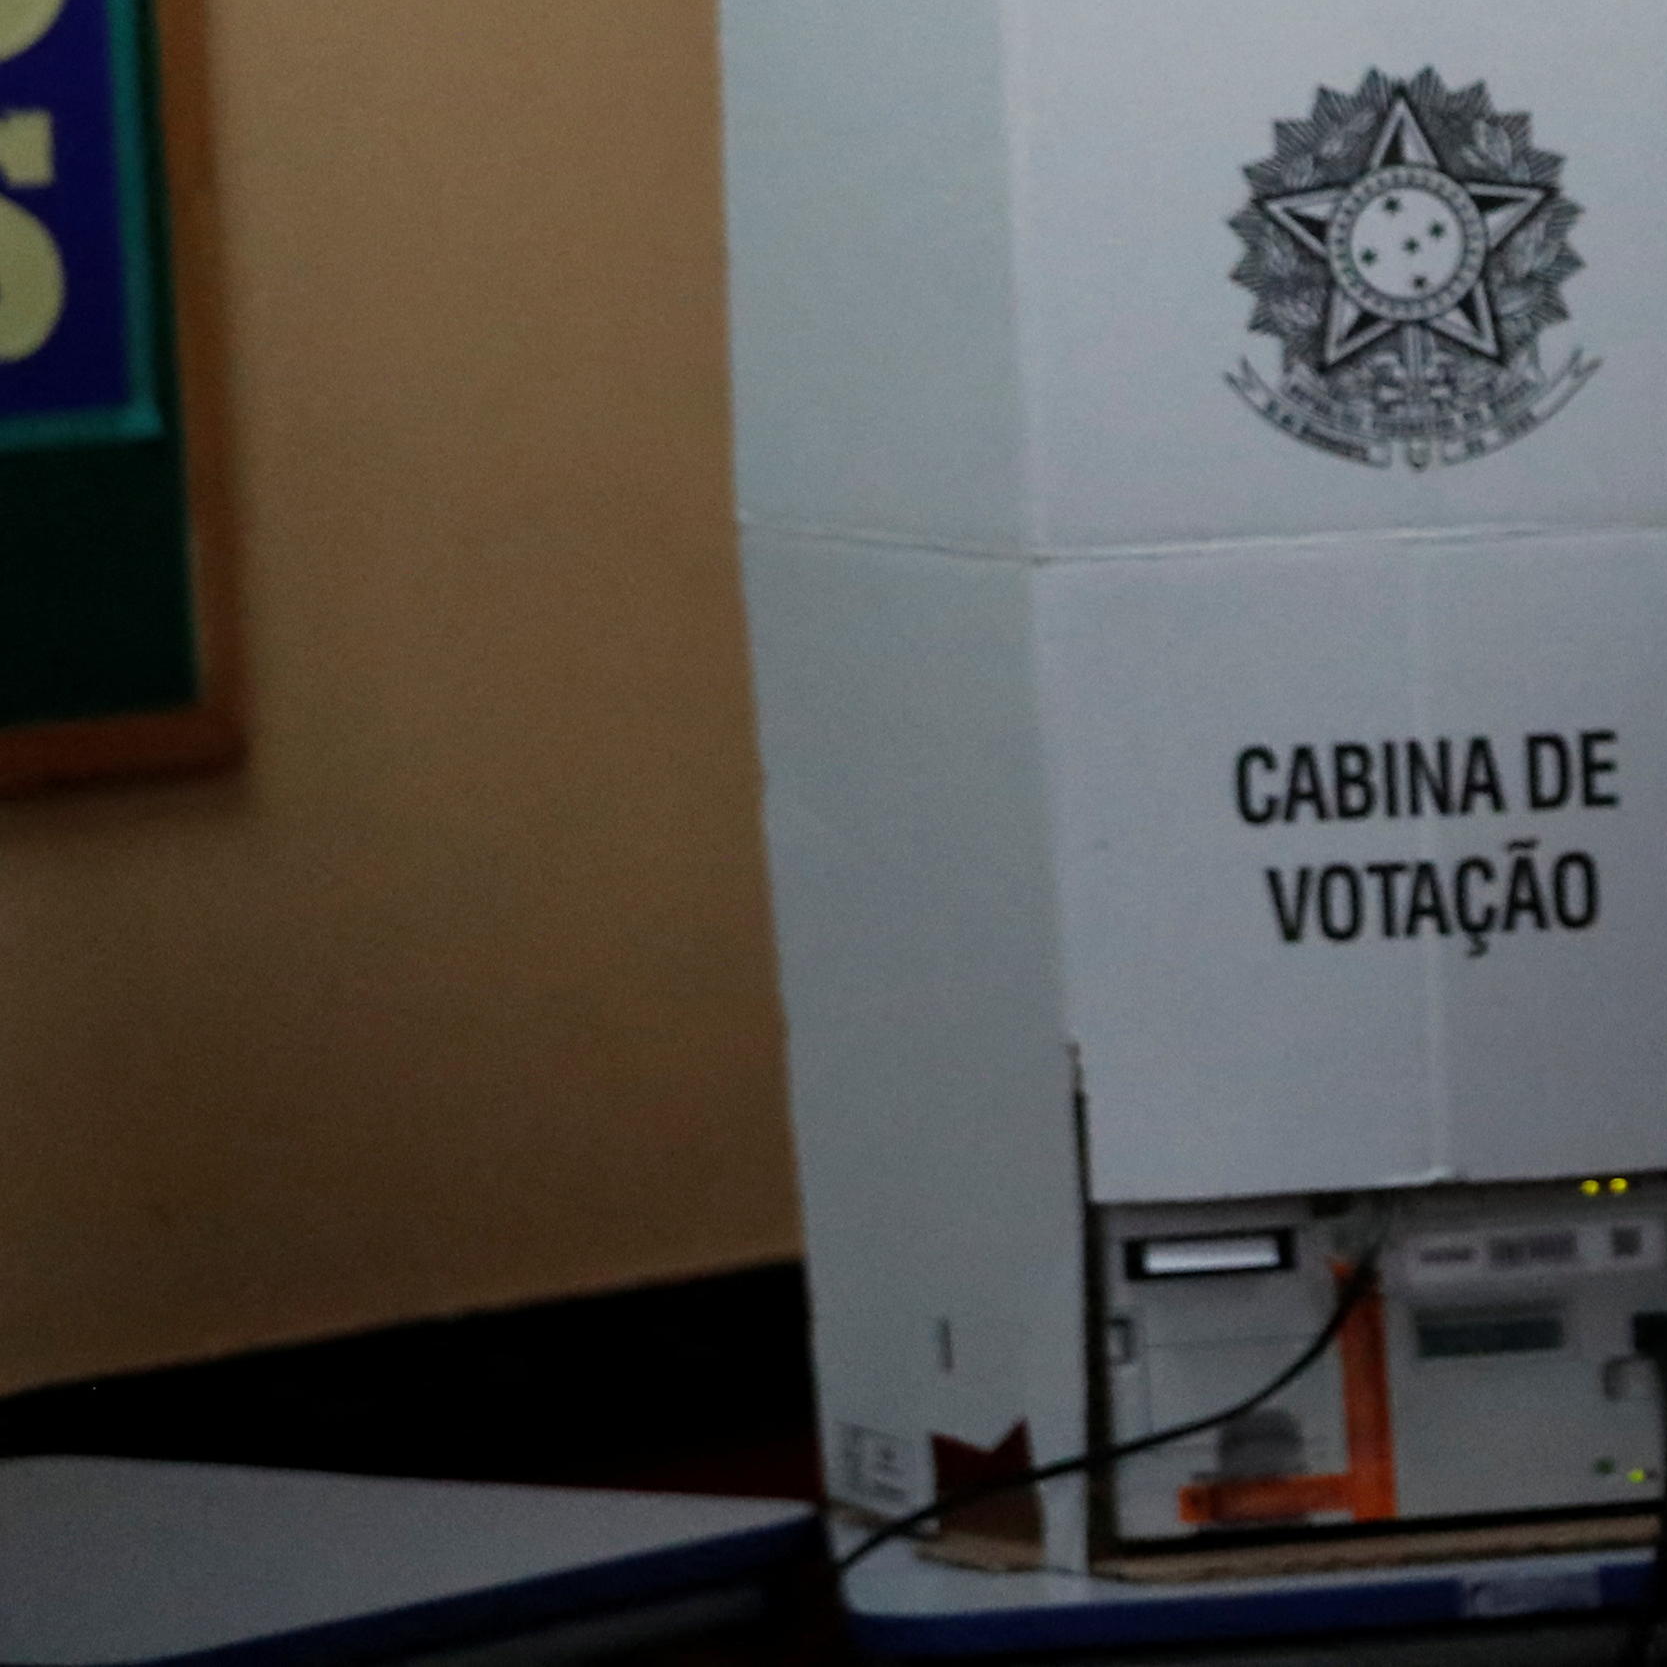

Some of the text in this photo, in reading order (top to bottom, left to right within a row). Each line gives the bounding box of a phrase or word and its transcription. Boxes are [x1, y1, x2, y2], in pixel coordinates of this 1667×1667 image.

[1235, 729, 1621, 825] CABINA DE
[1265, 839, 1599, 960] VOTAÇÃO
